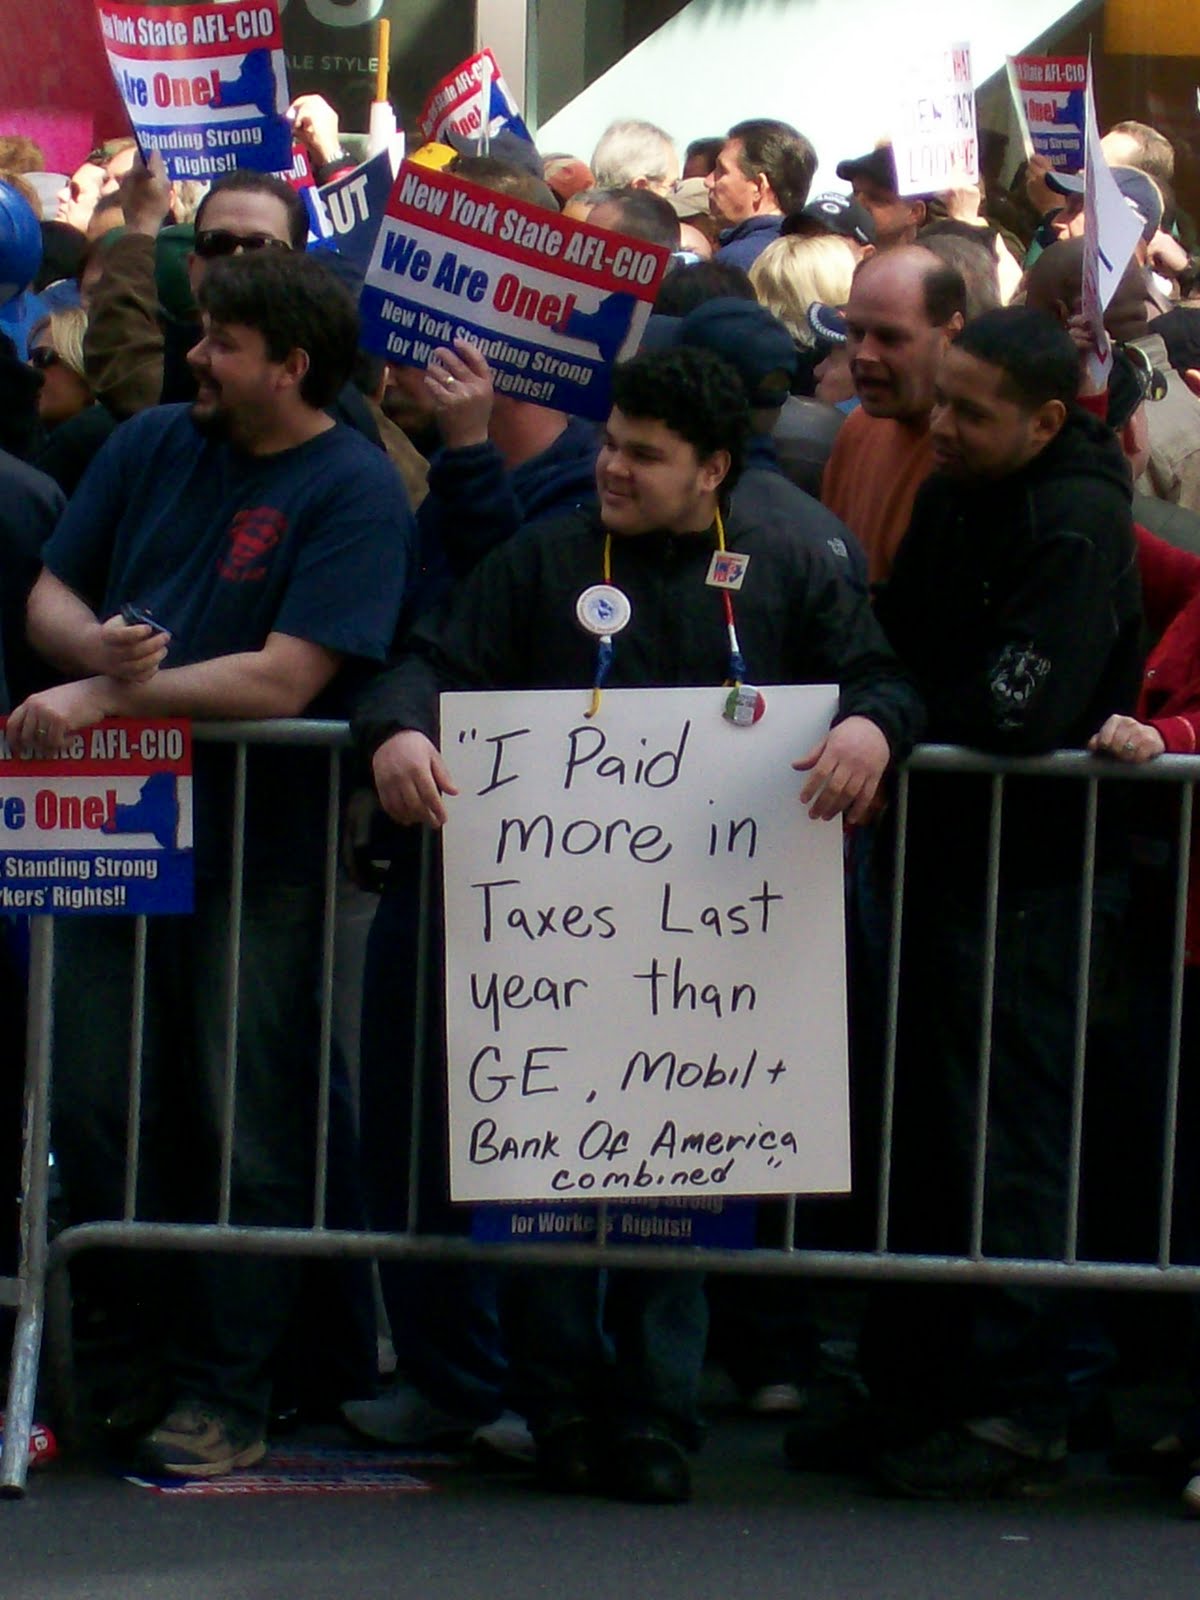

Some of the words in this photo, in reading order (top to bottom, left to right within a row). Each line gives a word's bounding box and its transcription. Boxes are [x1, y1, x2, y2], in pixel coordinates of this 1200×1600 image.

[138, 16, 187, 46] State
[193, 8, 273, 44] AFL-CIO
[321, 56, 390, 73] STYLE
[153, 69, 221, 108] One!
[206, 127, 262, 147] Strong
[174, 153, 237, 175] Rights!!
[399, 173, 449, 215] New
[449, 189, 497, 235] York
[499, 208, 564, 257] State
[563, 231, 657, 285] AFL-CIO
[380, 230, 432, 282] We
[432, 252, 489, 303] Are
[492, 272, 577, 333] One!
[381, 298, 416, 329] New
[417, 312, 453, 342] York
[455, 325, 531, 369] Standing
[531, 351, 593, 386] Strong
[386, 331, 411, 355] for
[90, 729, 183, 760] AFL-CIO
[564, 719, 691, 789] Paid
[35, 789, 117, 830] One!
[496, 814, 673, 864] more
[707, 799, 757, 858] in
[5, 857, 90, 880] Standing
[94, 857, 158, 880] Strong
[52, 886, 126, 909] Rights!!
[470, 879, 617, 943] Taxes
[661, 880, 784, 938] Last
[470, 973, 589, 1032] year
[632, 957, 756, 1018] than
[578, 1120, 630, 1163] Of
[650, 1120, 799, 1161] America
[551, 1159, 735, 1192] combined
[511, 1214, 535, 1234] for
[538, 1213, 616, 1234] Workes'
[622, 1213, 692, 1238] Rights!!
